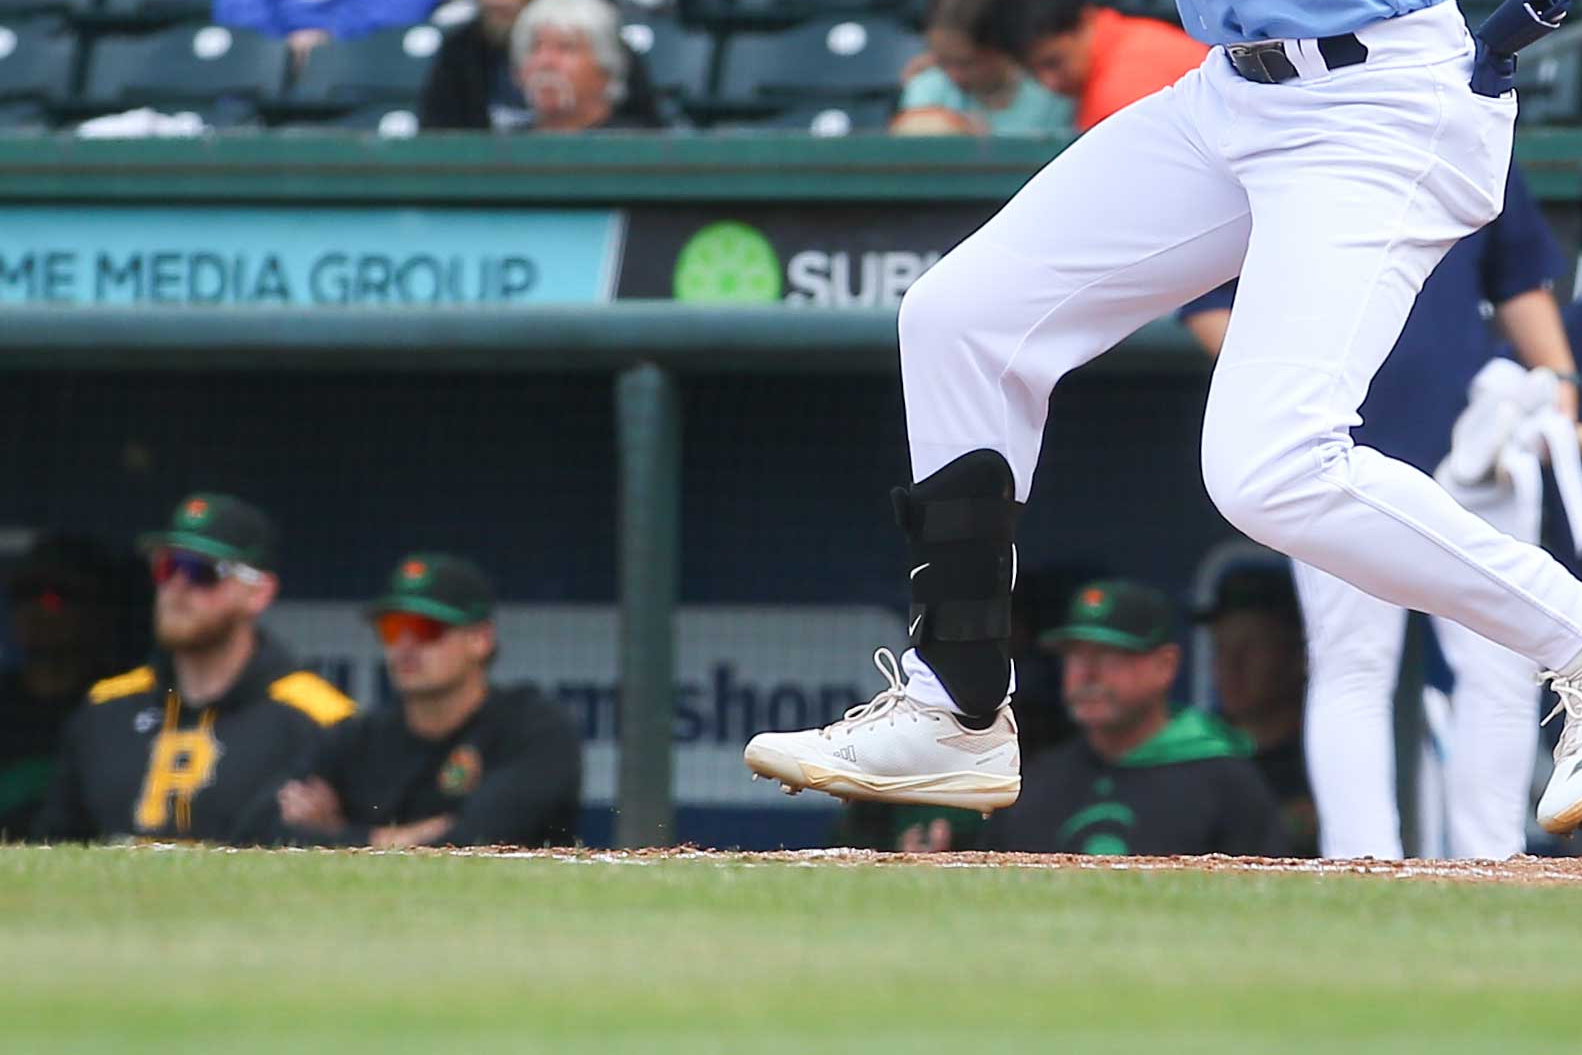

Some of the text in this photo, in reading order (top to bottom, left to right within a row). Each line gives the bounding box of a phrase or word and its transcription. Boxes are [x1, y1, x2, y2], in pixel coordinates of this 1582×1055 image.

[94, 250, 292, 304] MEDIA
[307, 250, 540, 305] GROUP
[786, 249, 942, 309] SUB
